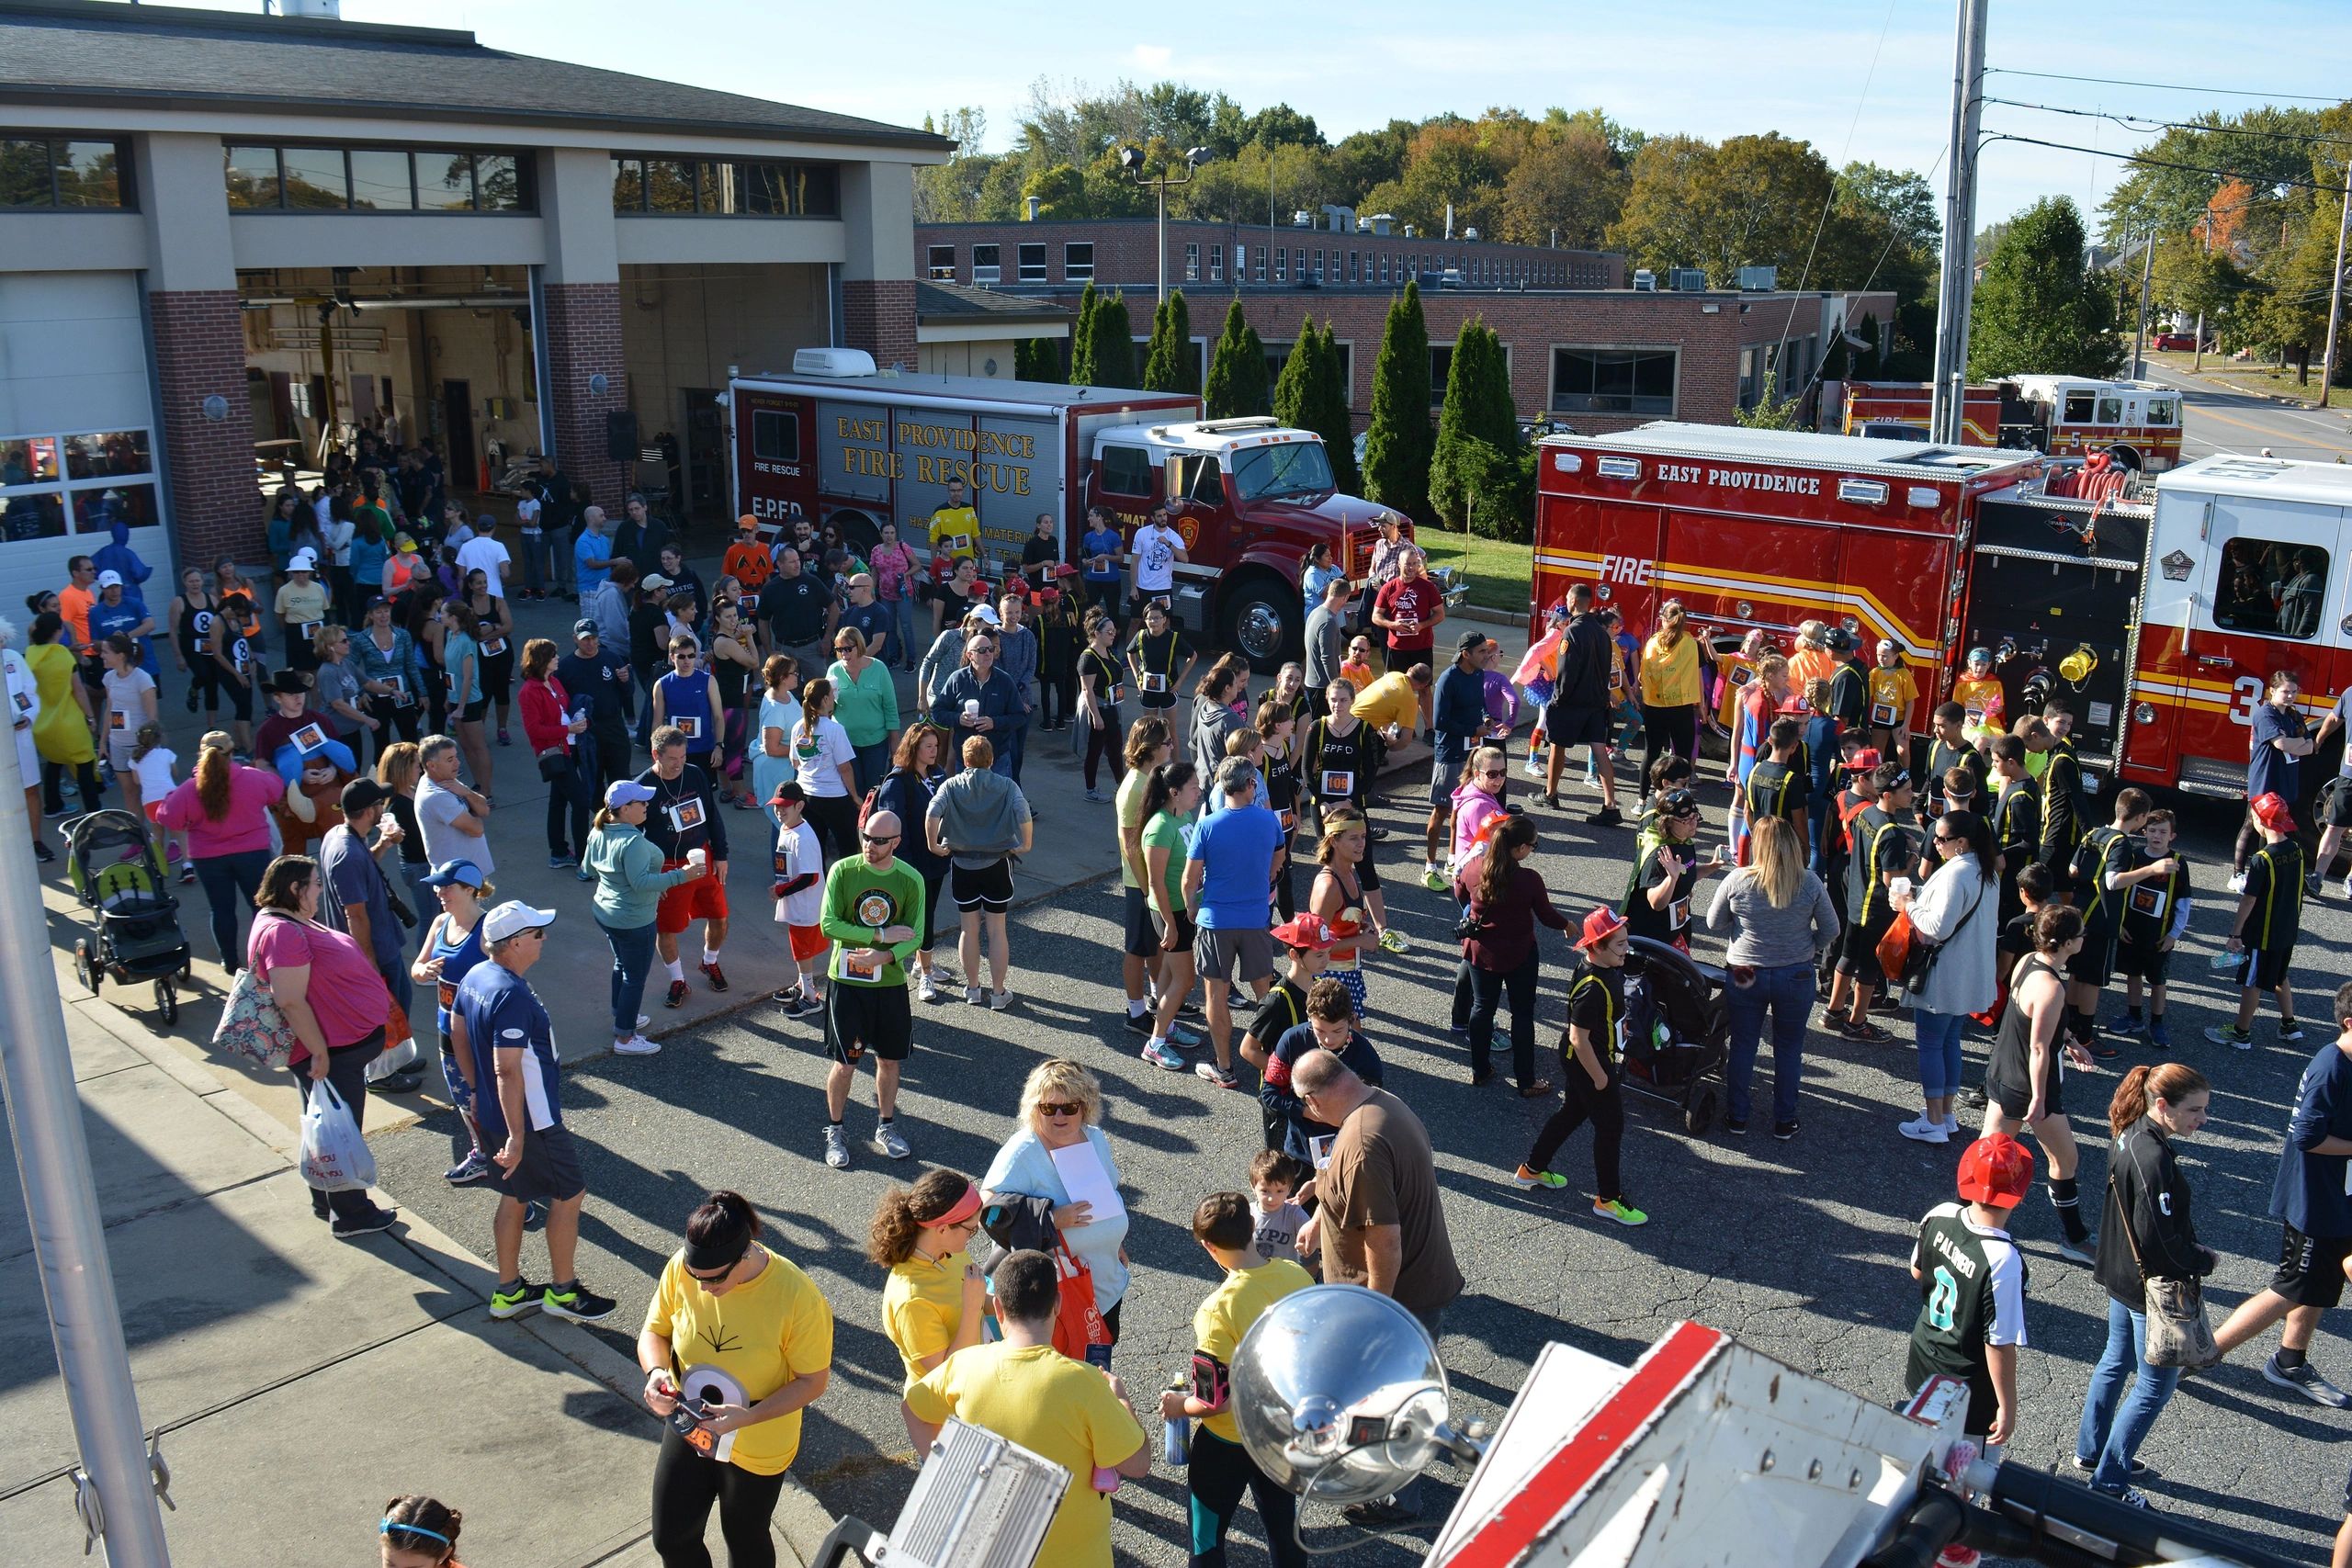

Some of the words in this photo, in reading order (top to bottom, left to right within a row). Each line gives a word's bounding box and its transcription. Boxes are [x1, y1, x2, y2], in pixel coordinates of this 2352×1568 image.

[837, 417, 884, 442] EAST
[898, 423, 1035, 458] PROVIDENCE
[2071, 432, 2081, 447] 5
[754, 462, 770, 472] FIRE
[772, 465, 800, 476] RESCUE
[843, 447, 904, 479] FIRE
[916, 456, 1031, 496] RESCUE
[1657, 464, 1702, 483] EAST
[1708, 469, 1820, 495] PROVIDENCE
[1599, 555, 1653, 585] FIRE
[199, 614, 209, 632] 8
[240, 640, 249, 660] 8
[2230, 676, 2264, 726] 3
[1324, 743, 1353, 754] EPFD
[2274, 850, 2301, 866] GRAC
[1255, 1227, 1290, 1245] YPD
